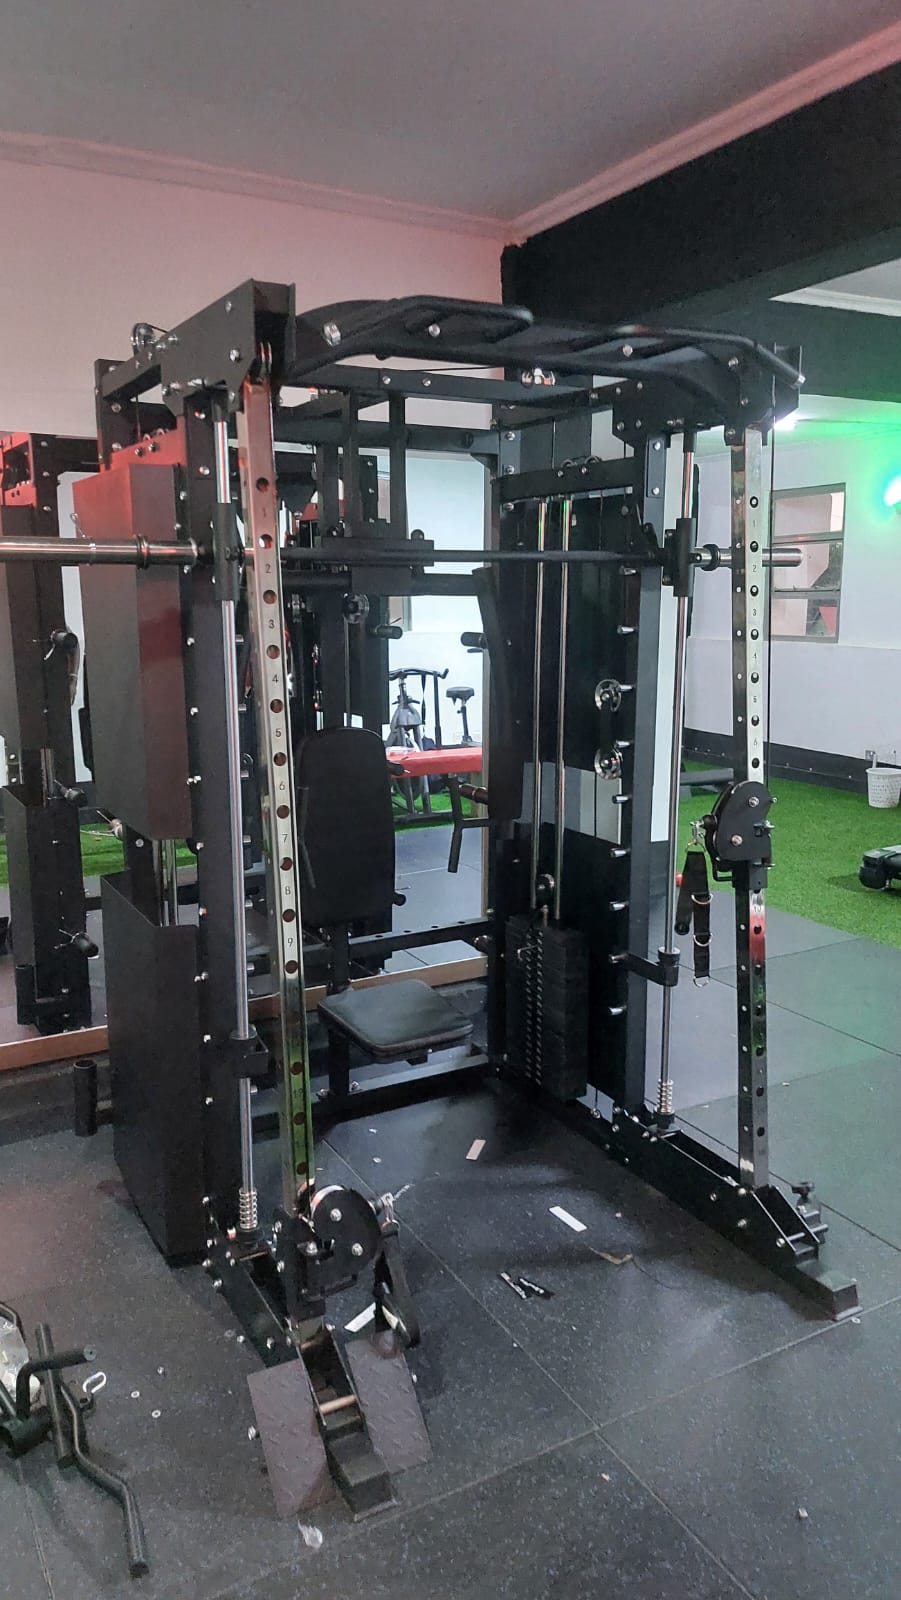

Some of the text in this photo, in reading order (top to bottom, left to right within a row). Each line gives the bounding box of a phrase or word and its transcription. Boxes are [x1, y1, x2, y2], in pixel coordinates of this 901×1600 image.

[265, 563, 272, 574] 2
[752, 564, 758, 573] 2
[752, 608, 758, 617] 3
[268, 619, 275, 629] 3
[271, 674, 279, 684] 4
[275, 728, 282, 738] 5
[278, 782, 285, 791] 6
[281, 833, 288, 844] 7
[284, 885, 291, 896] 8
[287, 937, 294, 947] 9
